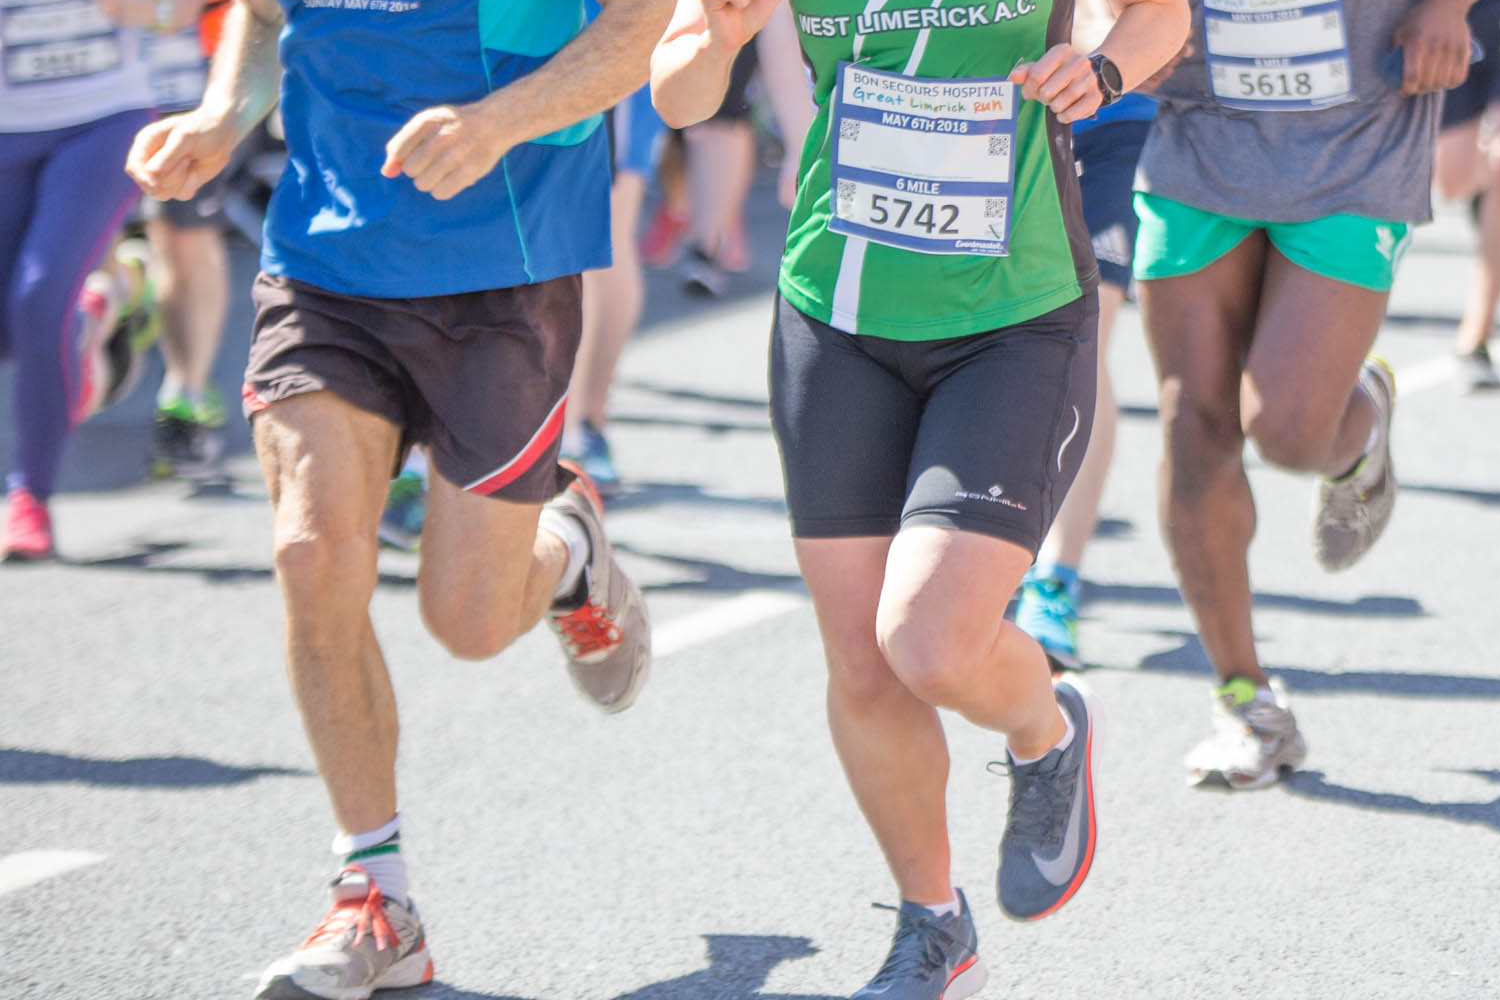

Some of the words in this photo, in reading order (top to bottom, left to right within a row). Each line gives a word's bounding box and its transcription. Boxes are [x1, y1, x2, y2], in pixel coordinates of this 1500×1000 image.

[798, 13, 850, 37] WEST
[856, 4, 990, 36] LIMERICK
[854, 72, 879, 88] BON
[881, 78, 940, 98] SECOURS
[943, 84, 1005, 99] HOSPITAL
[1239, 71, 1313, 97] 5618
[853, 86, 904, 106] Great
[910, 98, 967, 113] Limerick
[881, 112, 910, 128] MAY
[911, 116, 936, 132] 6TH
[937, 119, 969, 134] 2018
[896, 178, 906, 191] 6
[907, 180, 941, 195] MILE
[870, 194, 960, 235] 5742
